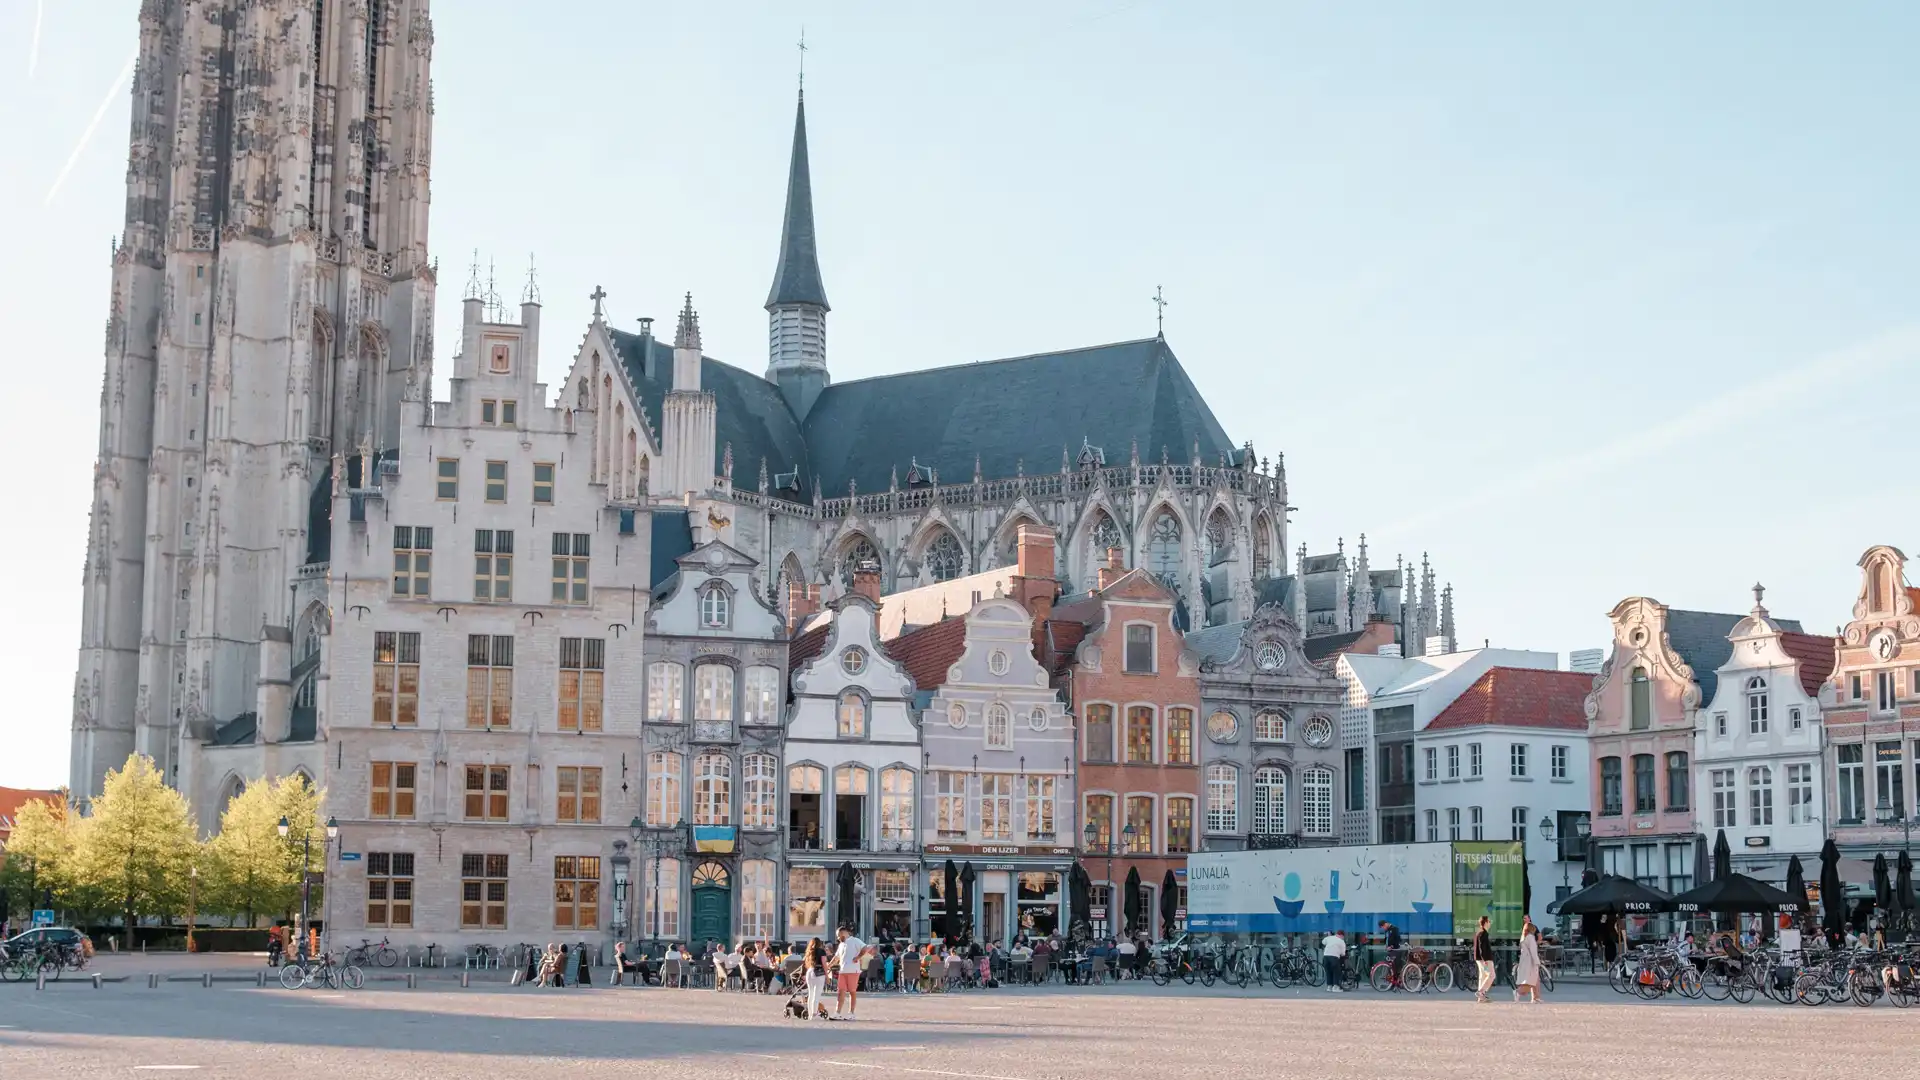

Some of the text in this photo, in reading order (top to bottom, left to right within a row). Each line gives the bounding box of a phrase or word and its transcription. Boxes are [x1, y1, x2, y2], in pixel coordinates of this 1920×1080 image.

[1455, 853, 1522, 864] FIETSENSTALLING
[1191, 866, 1230, 879] LUNALIA
[1625, 902, 1651, 910] PRIOR
[1679, 903, 1698, 911] PRIOR
